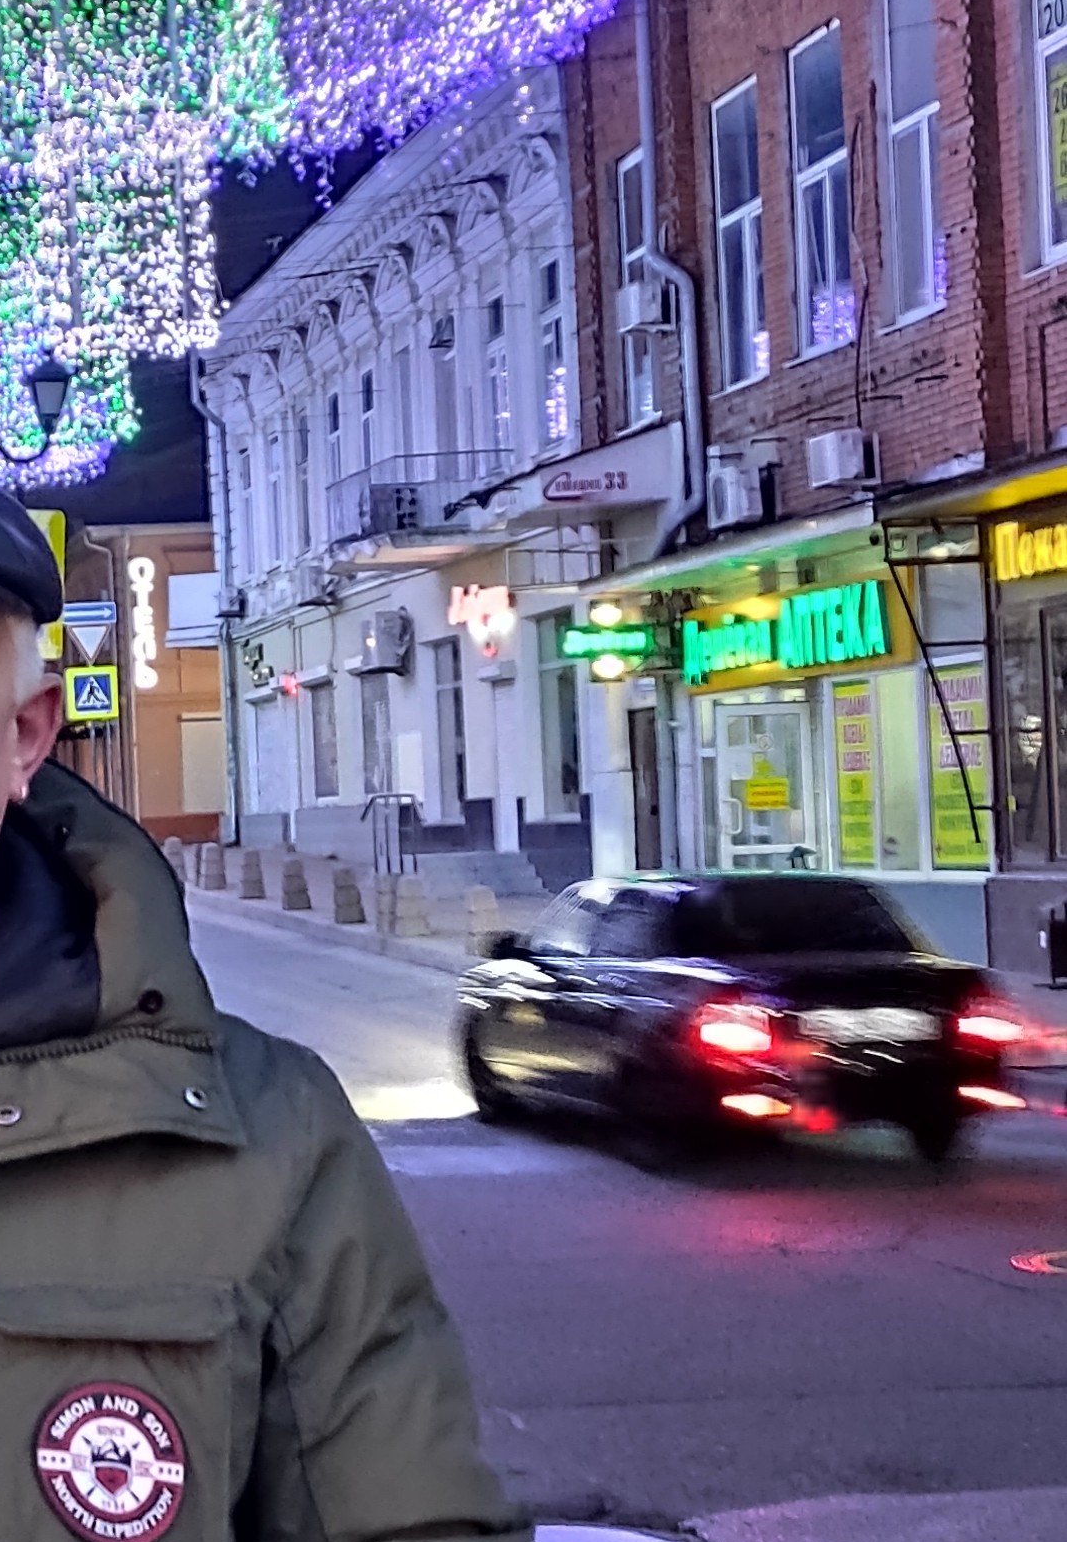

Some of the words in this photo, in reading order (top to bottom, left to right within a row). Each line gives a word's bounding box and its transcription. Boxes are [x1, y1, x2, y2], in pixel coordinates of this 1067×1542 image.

[128, 556, 159, 689] ОТЕЛЬ
[778, 579, 886, 669] АПТЕКА
[50, 1396, 96, 1440] SIMON
[102, 1394, 140, 1417] AND
[142, 1411, 173, 1449] SON
[51, 1474, 96, 1529] NORTH
[94, 1486, 174, 1538] EXPEDITION
